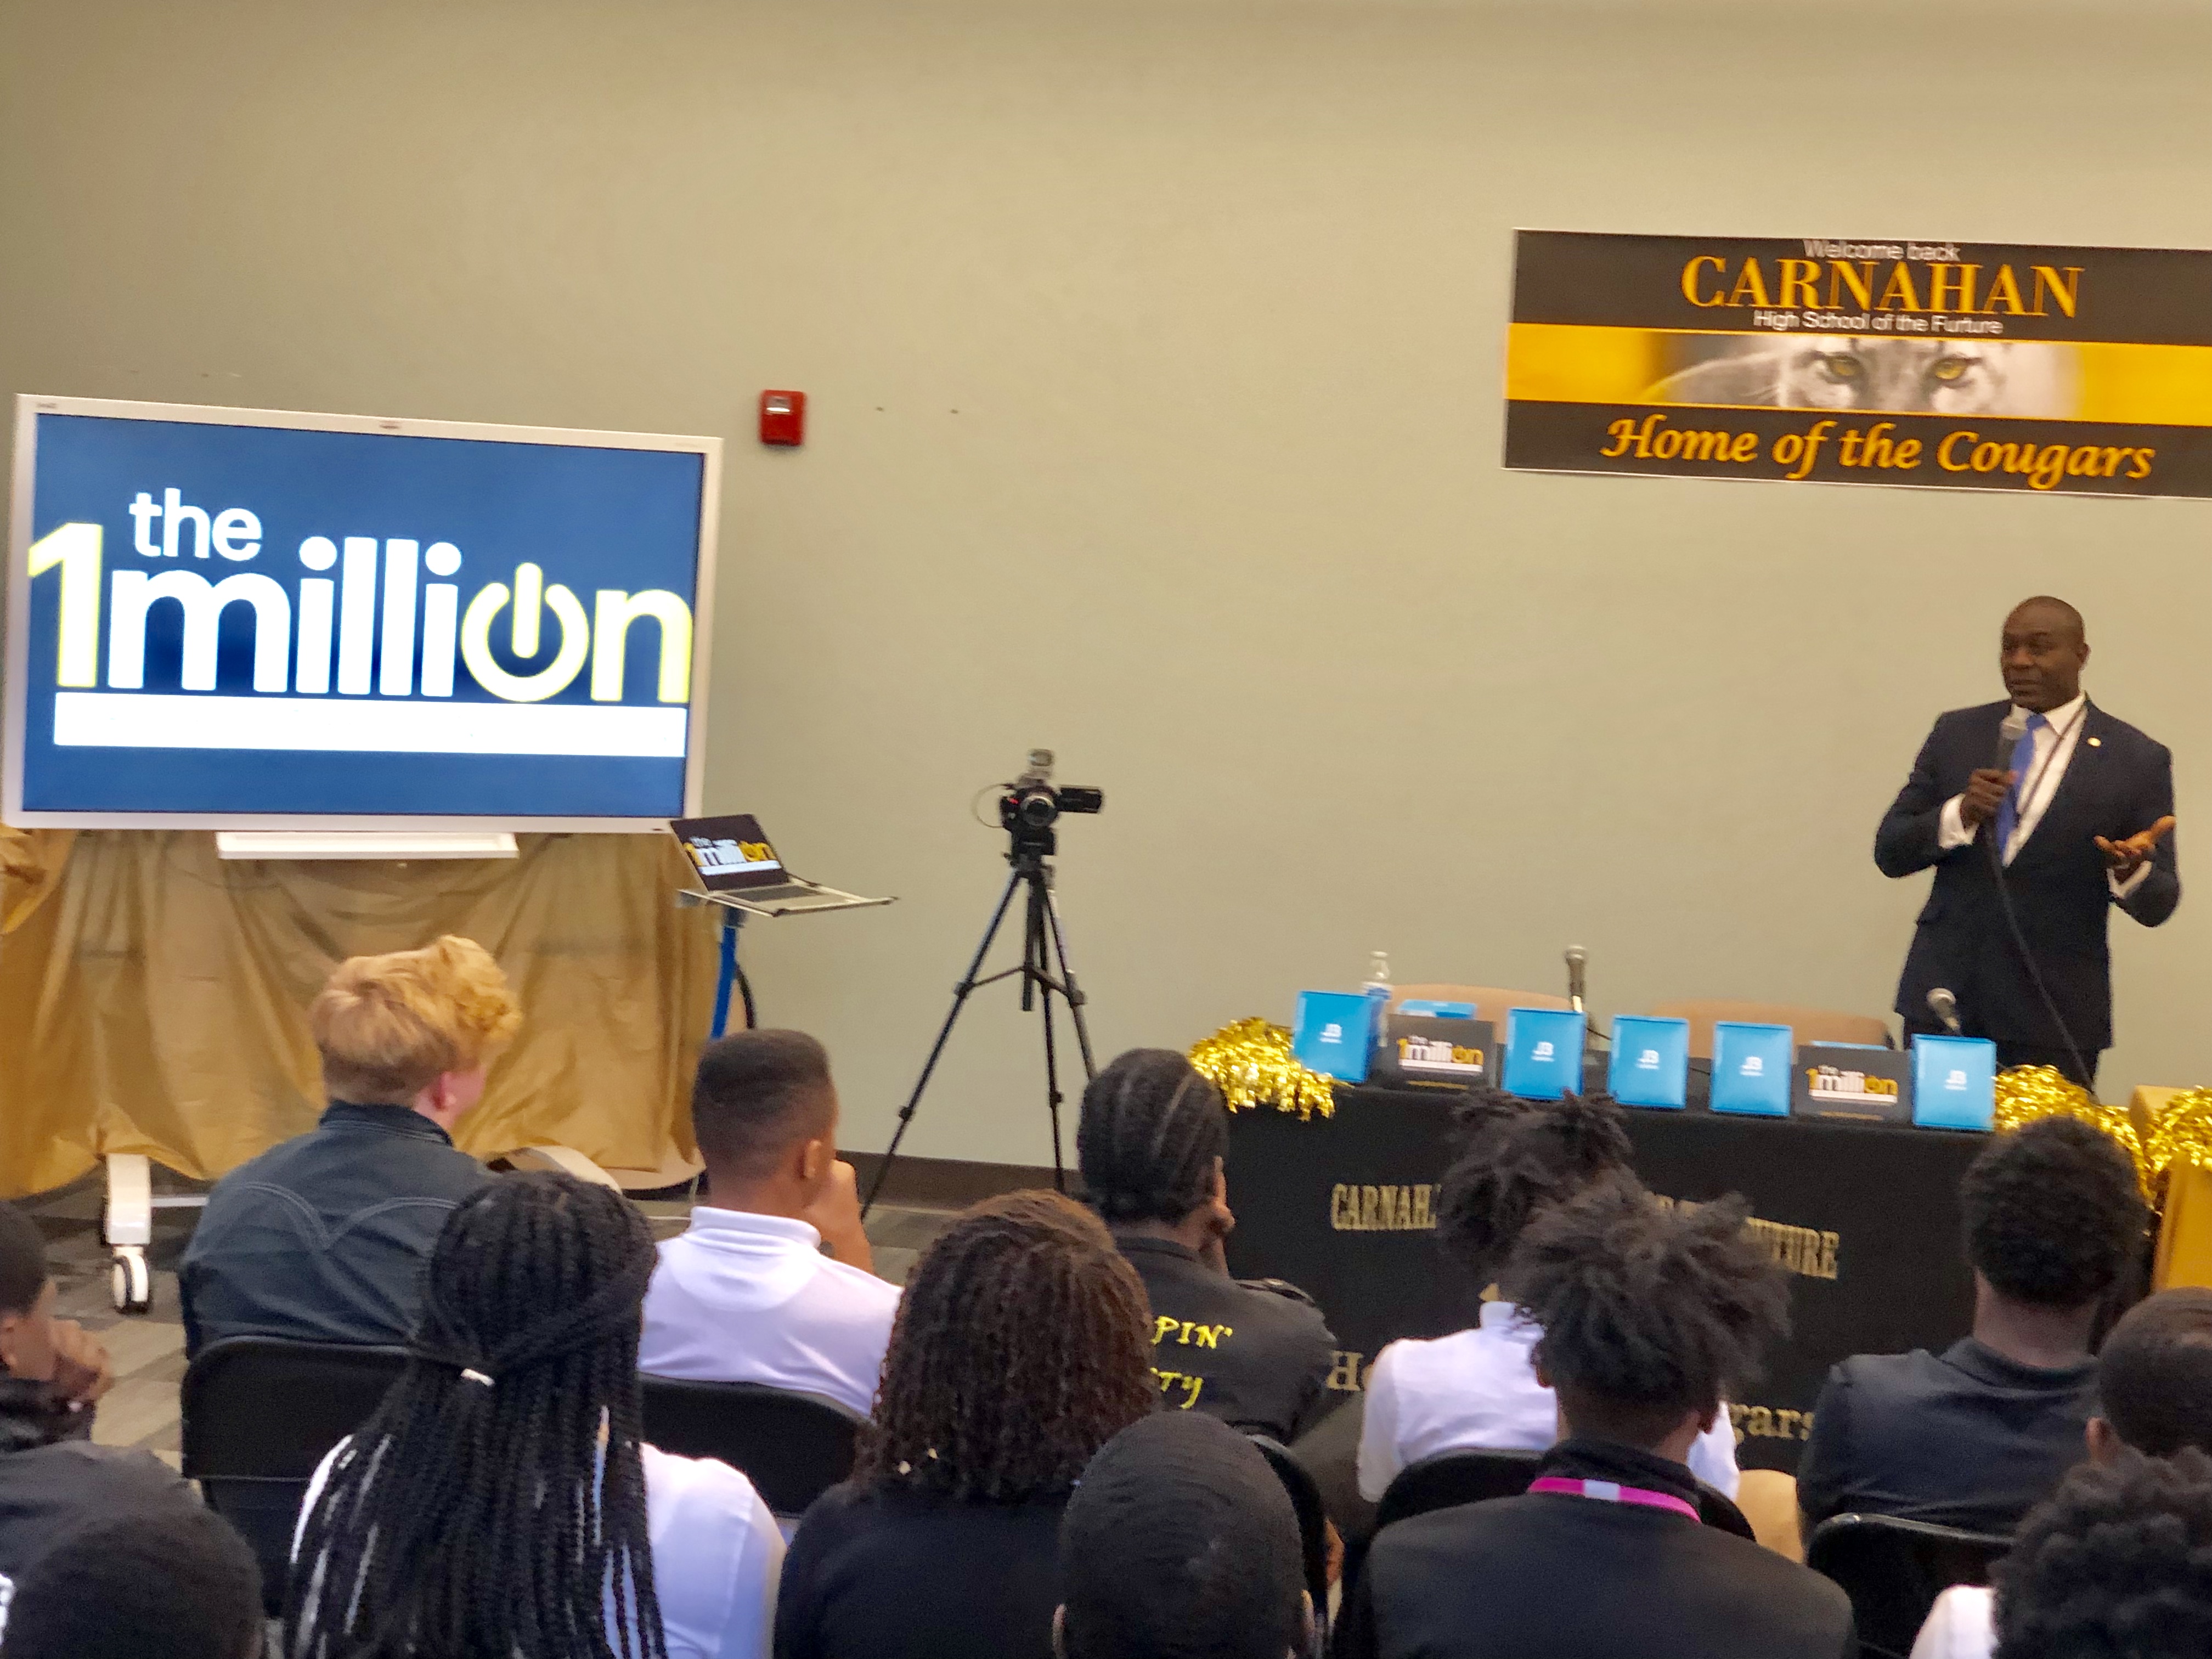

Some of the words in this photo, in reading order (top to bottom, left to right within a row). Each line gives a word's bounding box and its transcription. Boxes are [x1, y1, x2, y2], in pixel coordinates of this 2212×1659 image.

[1803, 239, 1904, 259] Welcome
[1906, 241, 1960, 262] back
[1680, 255, 2084, 318] CARNAHAN
[1753, 310, 1800, 330] High
[1802, 311, 1870, 330] School
[1871, 313, 1896, 331] of
[1895, 314, 1929, 332] the
[1600, 415, 1757, 461] Home
[1771, 420, 1837, 480] of
[1838, 423, 1921, 471] the
[1937, 431, 2155, 490] Cougars
[129, 488, 262, 560] the
[1330, 1183, 1441, 1231] CARNAH
[1150, 1315, 1233, 1349] PIN'
